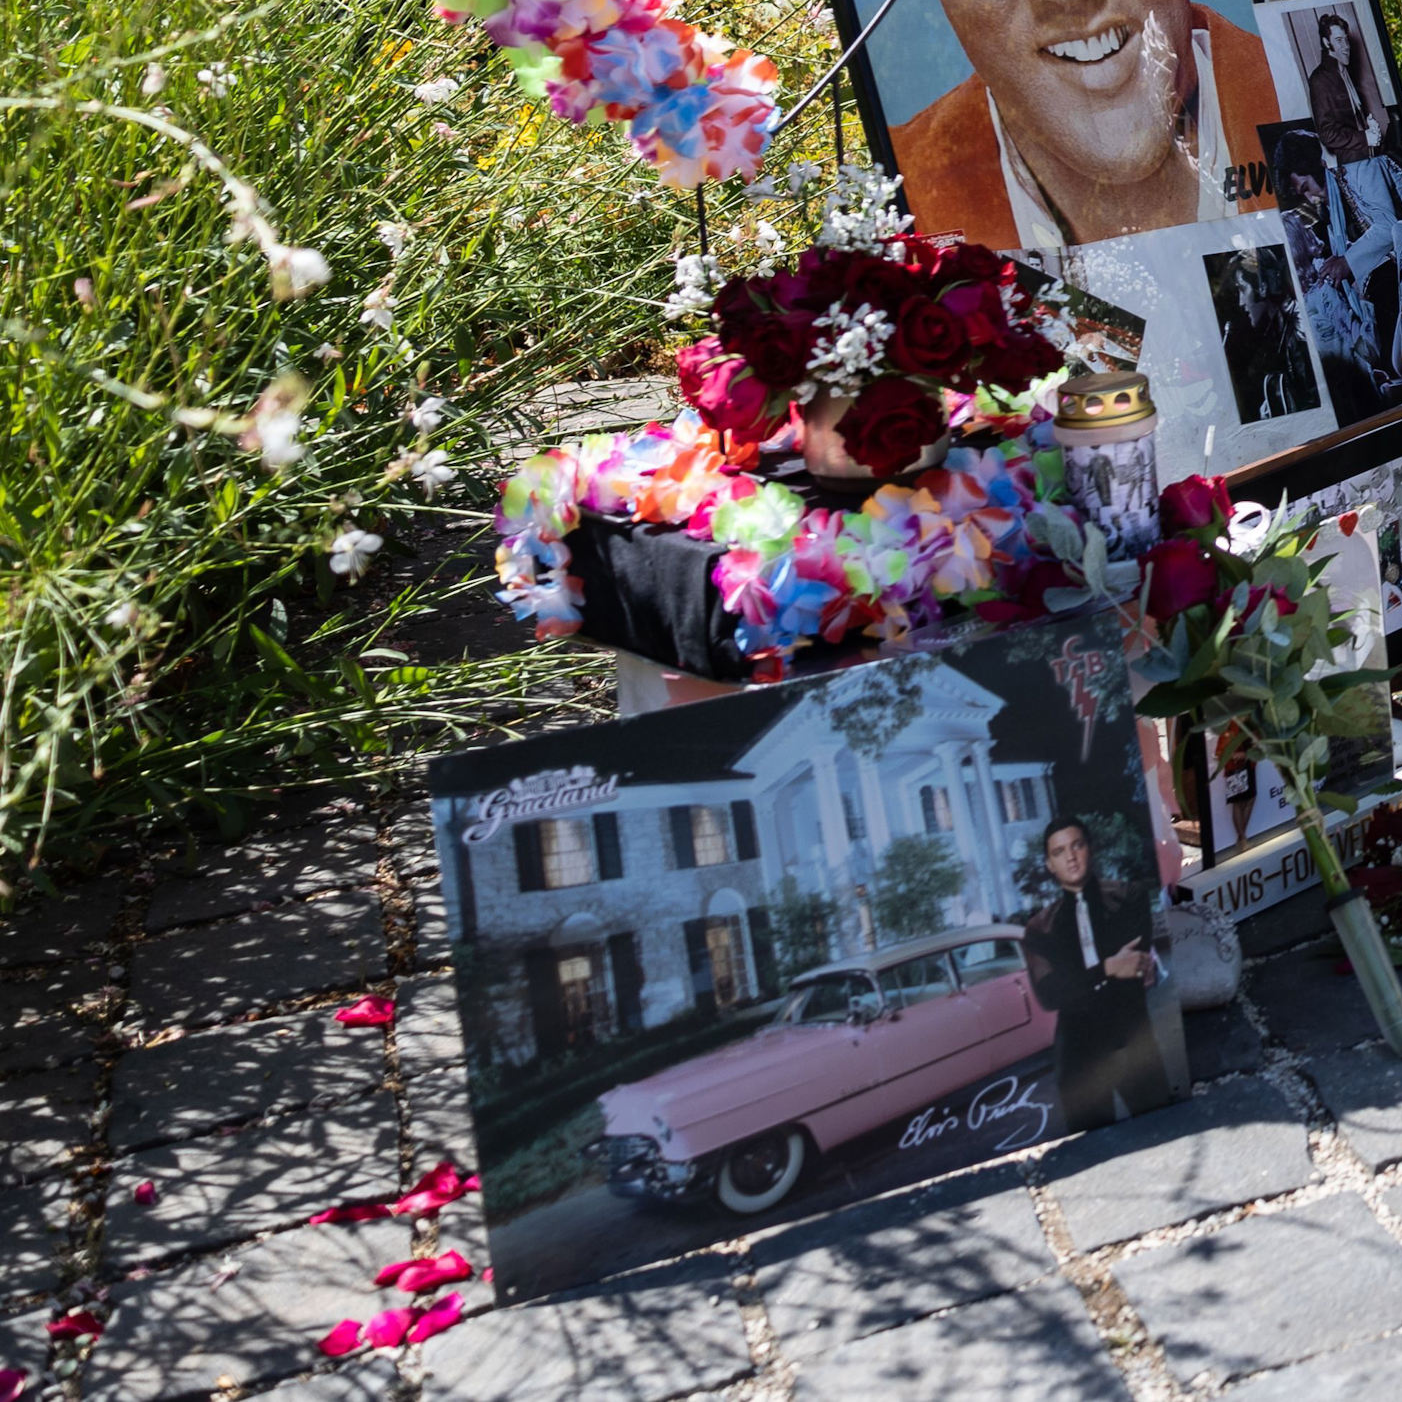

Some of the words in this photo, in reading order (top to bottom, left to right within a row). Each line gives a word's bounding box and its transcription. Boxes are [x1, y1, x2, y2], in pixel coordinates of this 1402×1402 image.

[1224, 161, 1274, 202] ELVI
[461, 773, 619, 844] Graceland
[898, 1106, 958, 1149] Elvis
